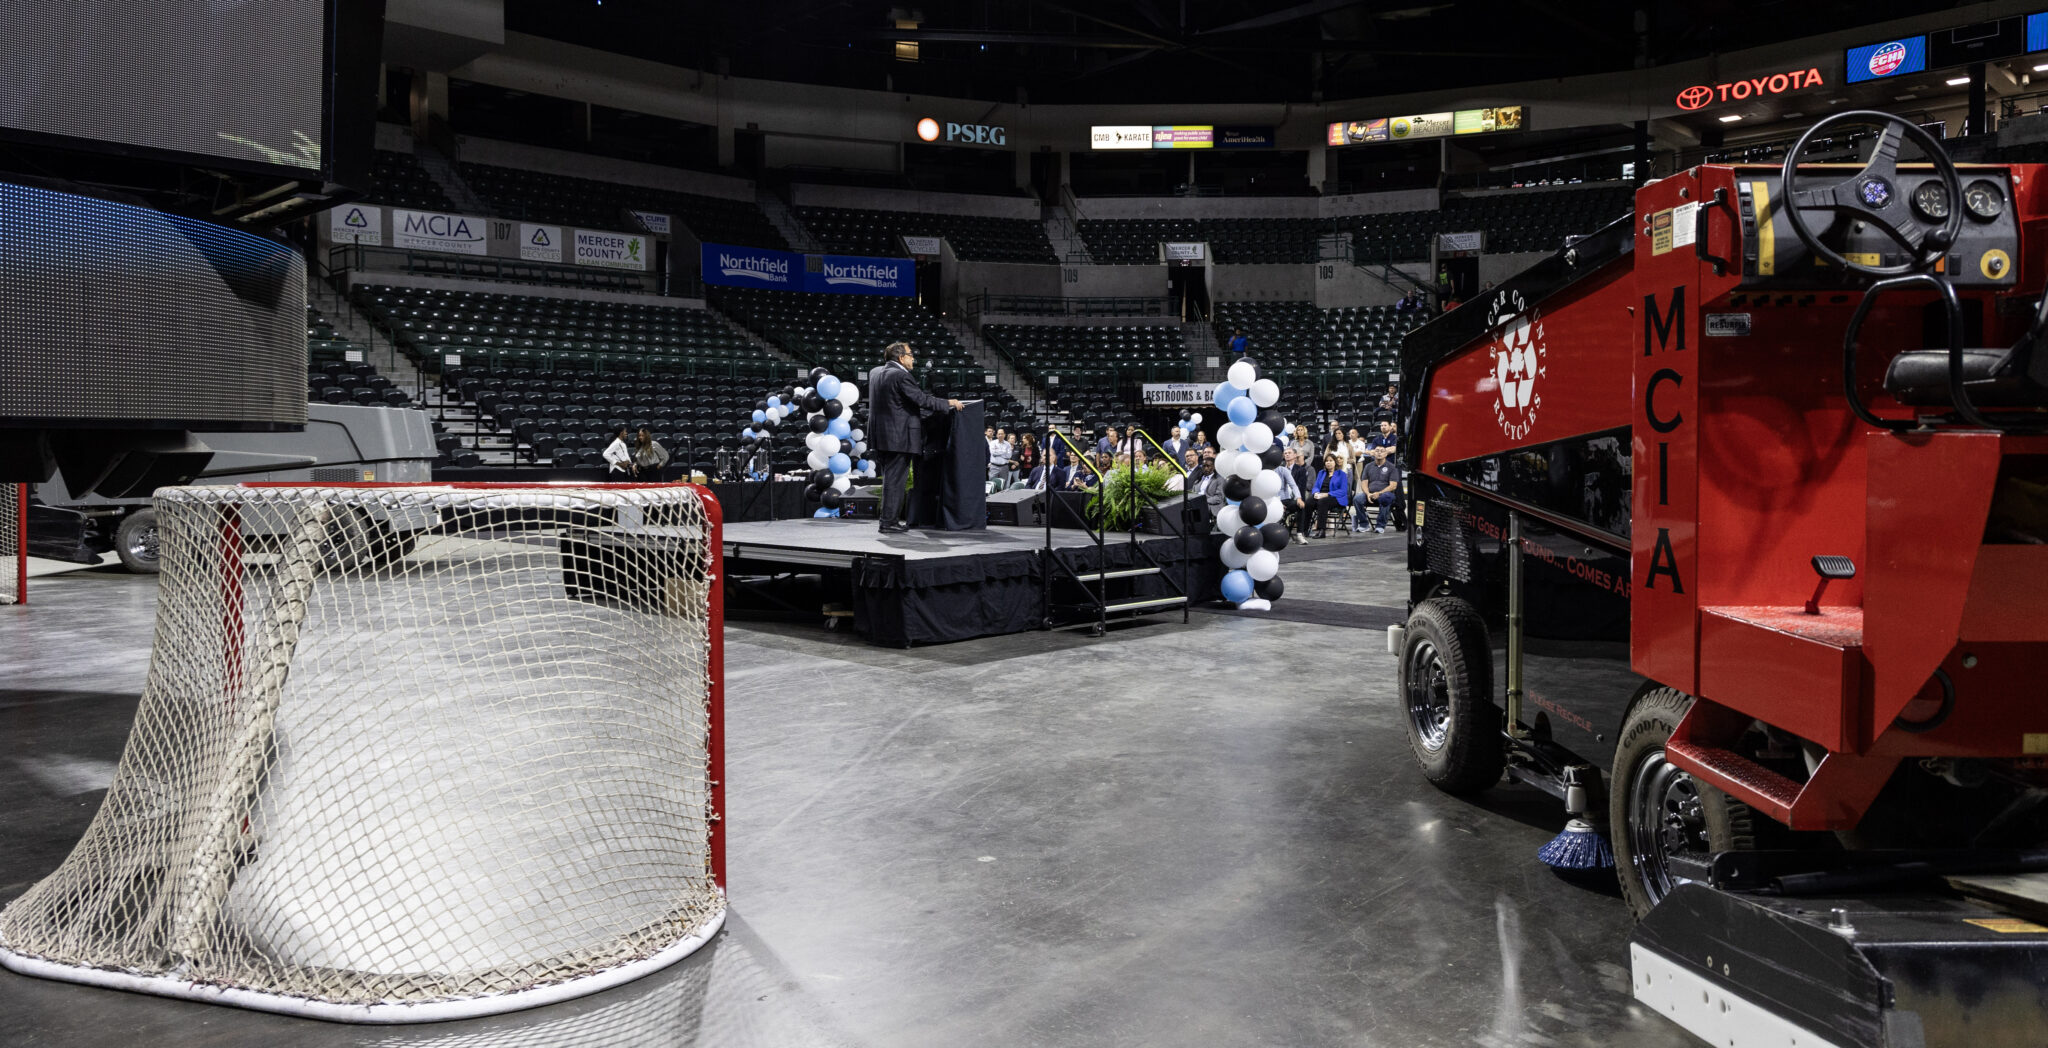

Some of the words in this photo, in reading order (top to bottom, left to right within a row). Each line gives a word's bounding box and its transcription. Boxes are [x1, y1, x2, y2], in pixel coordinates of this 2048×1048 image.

[1869, 47, 1905, 68] ECHL
[1717, 68, 1823, 102] TOYOTA
[946, 122, 1006, 145] PSEG
[1094, 133, 1110, 142] CMB
[1124, 132, 1150, 142] KARATE
[404, 213, 472, 238] MCIA
[646, 215, 667, 223] CURE
[494, 222, 512, 240] 107
[404, 238, 436, 246] MERCER
[439, 241, 472, 249] COUNTY
[578, 234, 625, 249] MERCER
[521, 250, 561, 261] RECYCLES
[578, 247, 623, 260] COUNTY
[601, 261, 643, 270] COMMUNITIES
[720, 253, 788, 274] Northfield
[824, 263, 898, 280] Northfield
[769, 273, 788, 283] Bank
[1063, 268, 1078, 284] 109
[1319, 264, 1334, 280] 109
[877, 279, 898, 289] Bank
[1146, 390, 1194, 403] RESTROOMS
[1196, 391, 1203, 401] &
[1493, 393, 1541, 441] RECYCLES
[1644, 285, 1686, 595] MCIA
[1477, 515, 1500, 540] GOES
[1567, 555, 1612, 591] COMES
[1613, 576, 1632, 600] AR
[1556, 703, 1593, 733] RECYCLE
[1623, 718, 1675, 749] GOODYE
